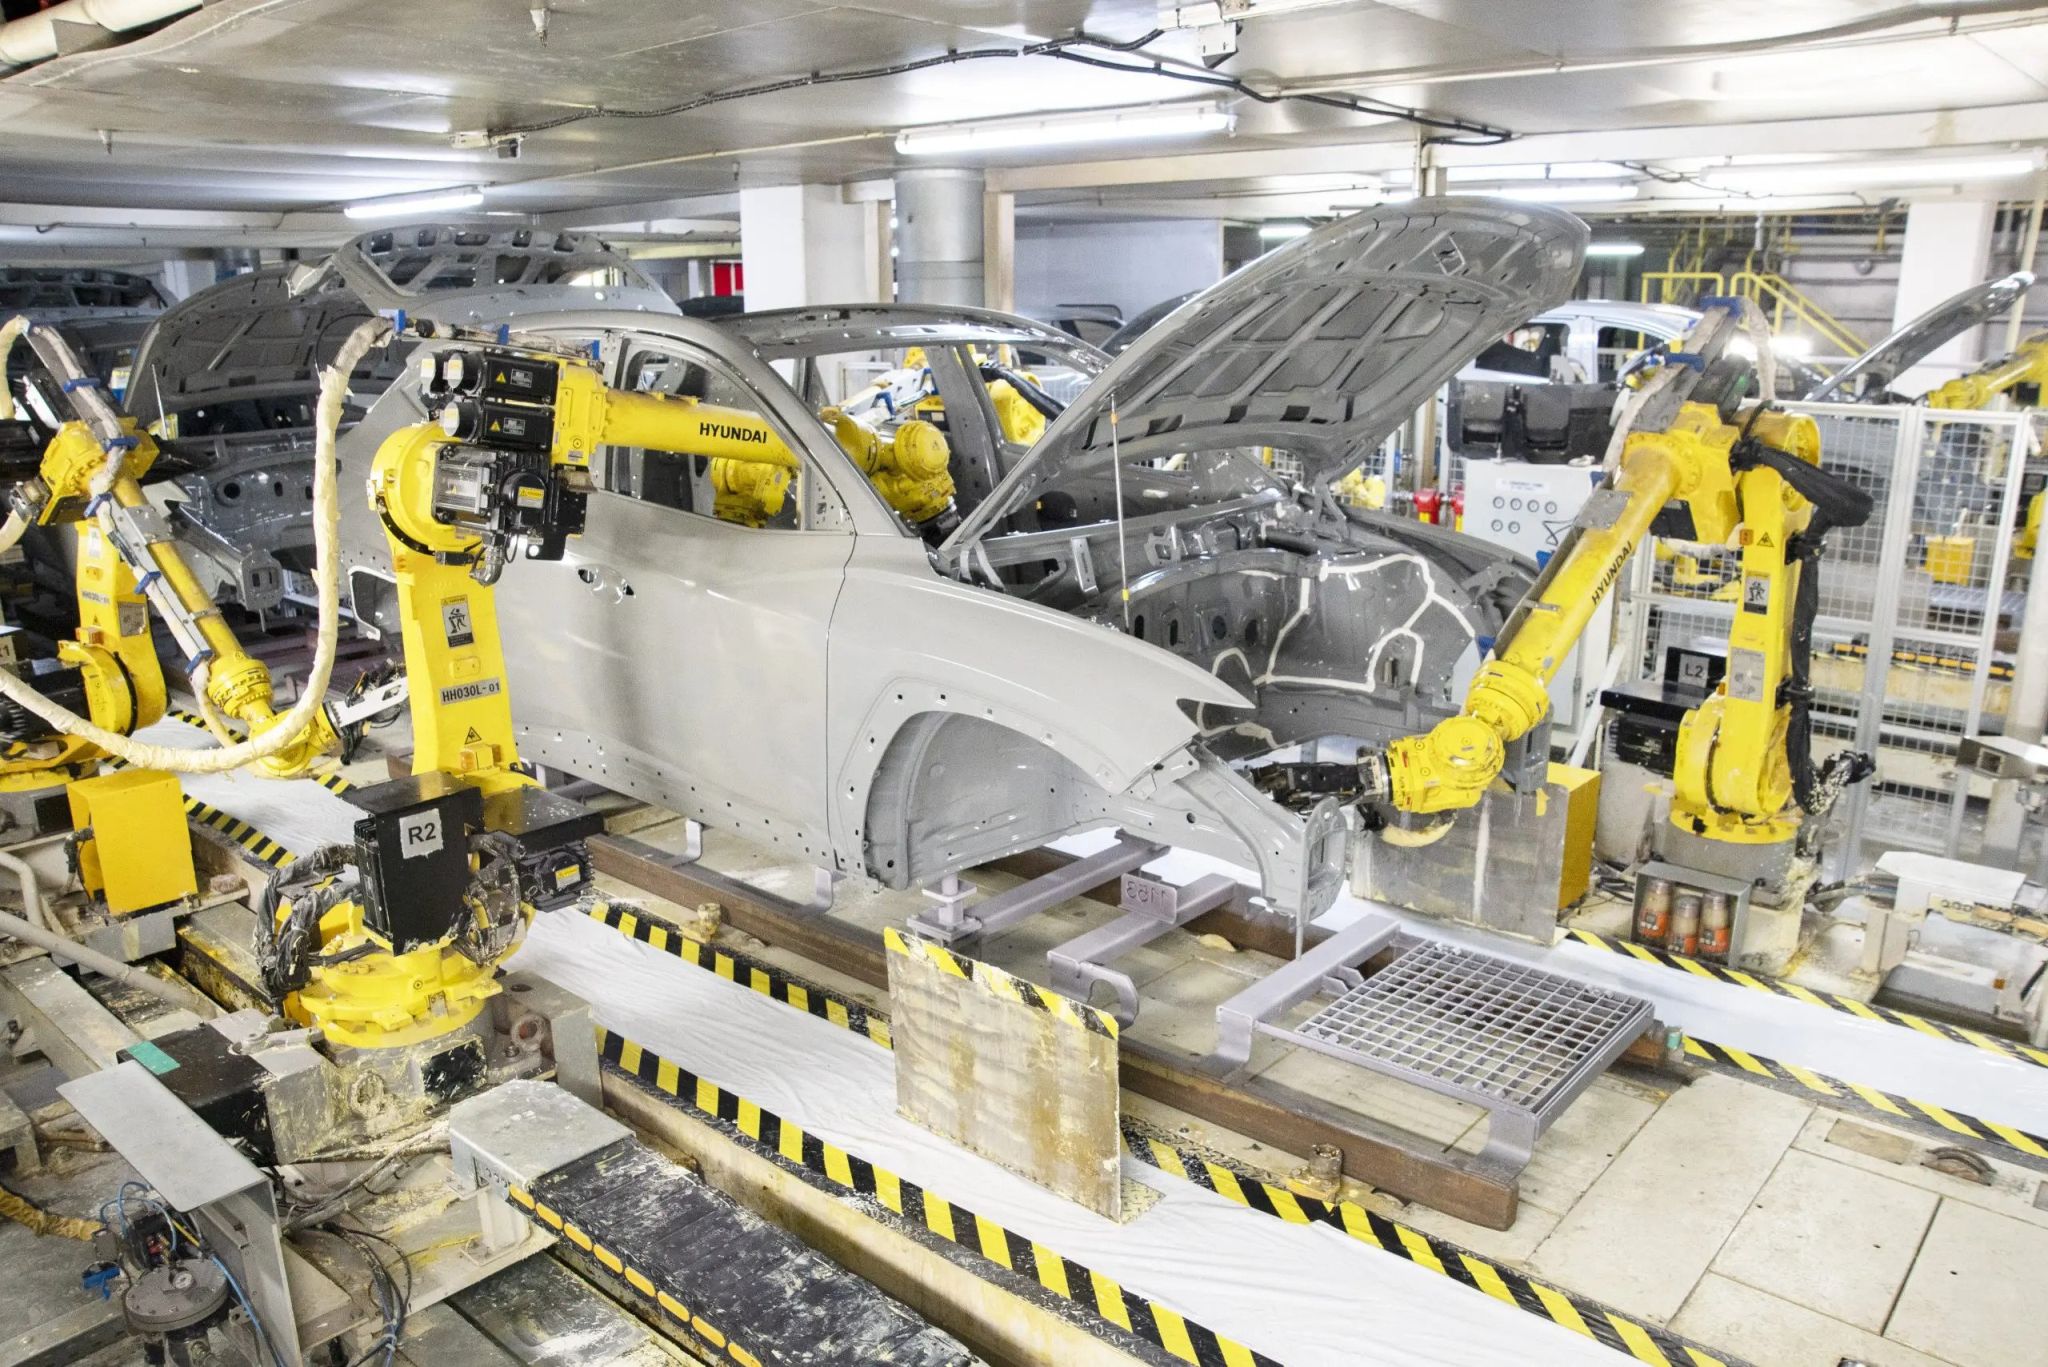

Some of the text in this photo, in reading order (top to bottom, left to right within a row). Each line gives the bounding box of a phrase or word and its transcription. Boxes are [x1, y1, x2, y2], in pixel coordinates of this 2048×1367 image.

[699, 422, 767, 444] HYUNDAI
[1591, 540, 1632, 605] HYUNDAI
[0, 645, 10, 657] 1
[1684, 663, 1704, 679] L2
[442, 682, 500, 702] HH030L-01
[408, 822, 437, 845] R2
